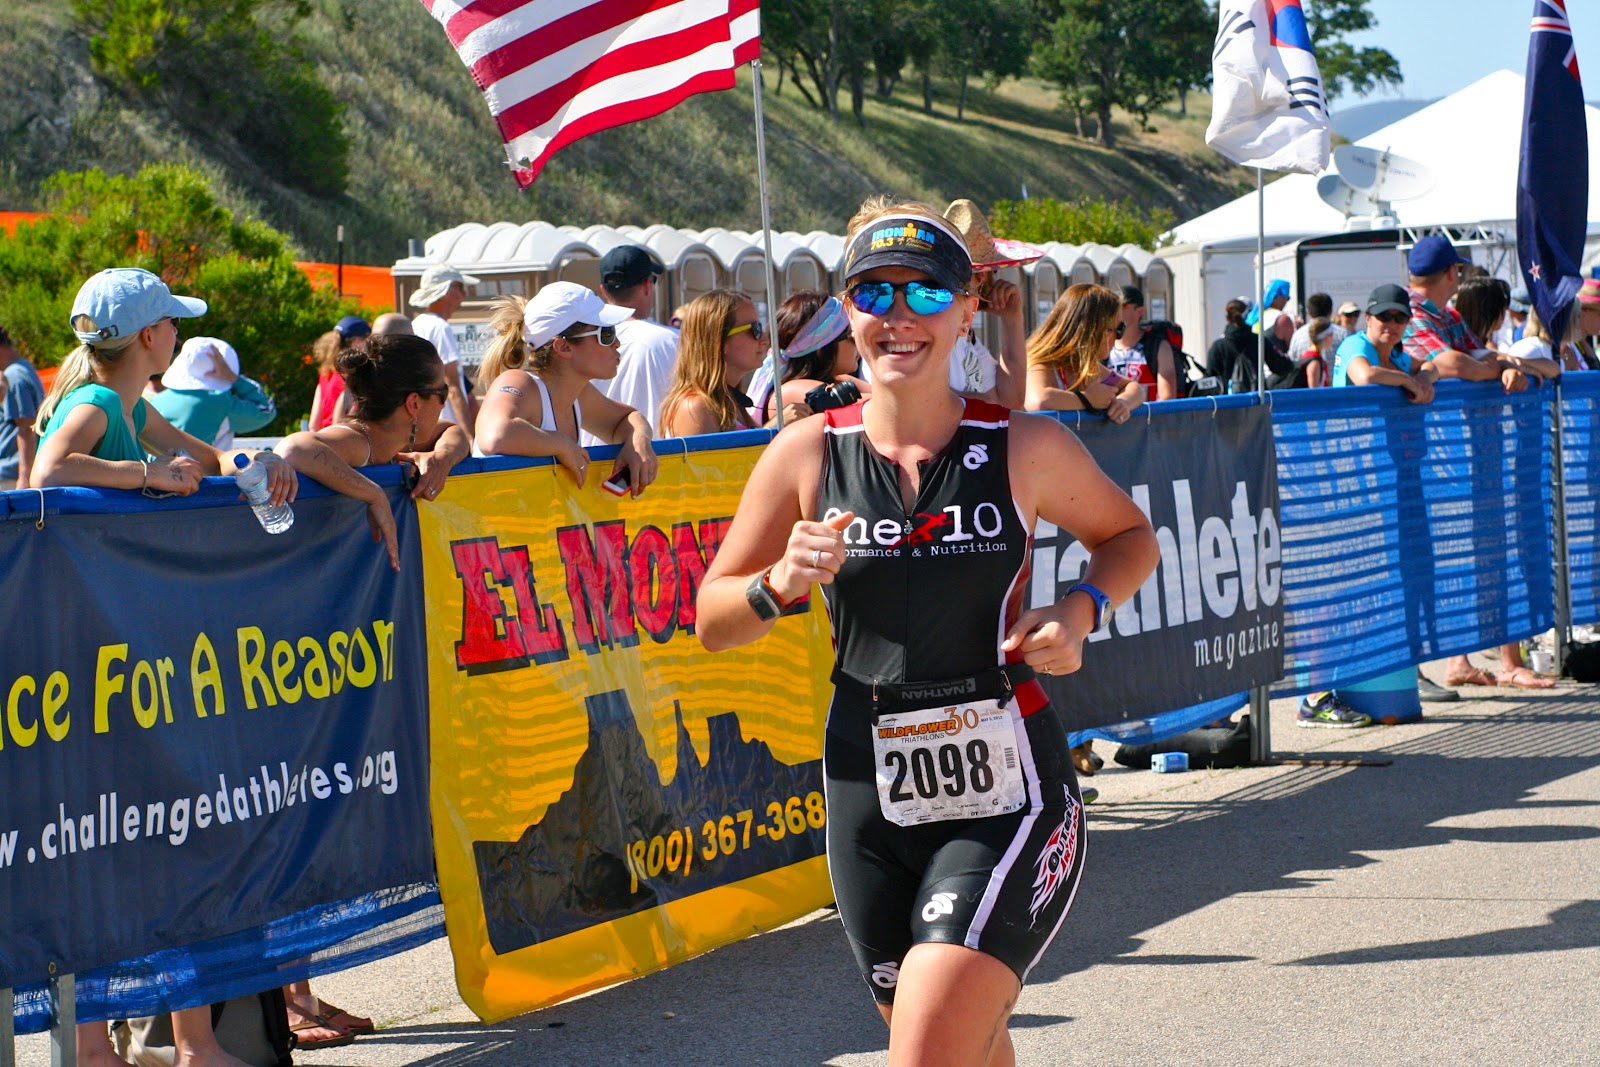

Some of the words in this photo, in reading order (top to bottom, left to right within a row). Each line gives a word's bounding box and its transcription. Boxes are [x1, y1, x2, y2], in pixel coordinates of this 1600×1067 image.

[871, 237, 894, 250] 70.3
[872, 224, 935, 244] IRONMAN
[844, 548, 901, 557] ormance
[912, 547, 922, 557] &
[931, 542, 1007, 556] Nutrition
[450, 536, 570, 677] EL
[556, 516, 737, 656] MON
[1194, 615, 1280, 670] magazine
[0, 671, 71, 751] ce
[94, 643, 175, 734] For
[190, 632, 226, 719] A
[236, 620, 395, 709] Reason
[901, 685, 965, 700] NATHAN
[878, 720, 957, 739] WILDFLOWER
[944, 707, 979, 737] 30
[901, 733, 945, 744] TRIATHLONS
[884, 739, 994, 803] 2098
[627, 826, 694, 894] (800)
[702, 791, 827, 861] 367-368
